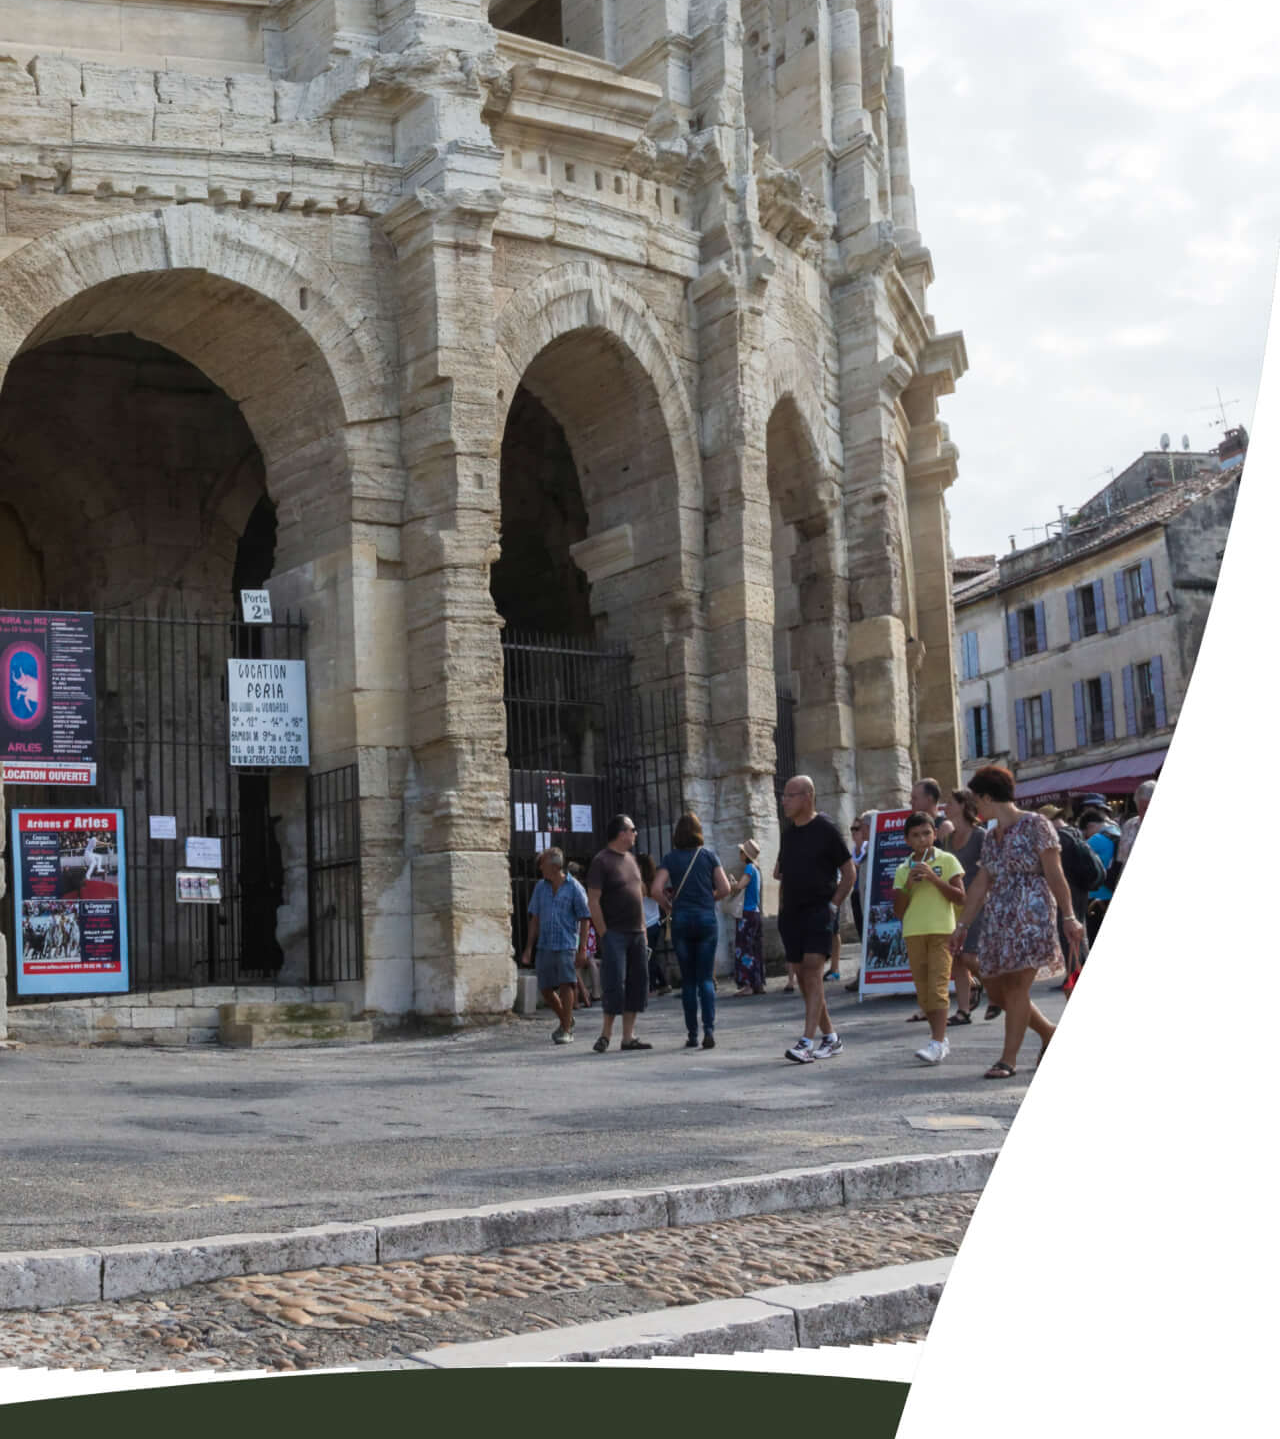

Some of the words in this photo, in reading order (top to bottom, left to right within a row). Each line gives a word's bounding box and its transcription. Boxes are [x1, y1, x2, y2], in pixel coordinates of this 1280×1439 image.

[243, 592, 268, 604] Porte
[7, 743, 42, 753] ARLES
[3, 768, 46, 781] LOCATION
[48, 770, 89, 782] OUVERTE
[27, 819, 61, 829] Arènes
[74, 816, 109, 829] Arles
